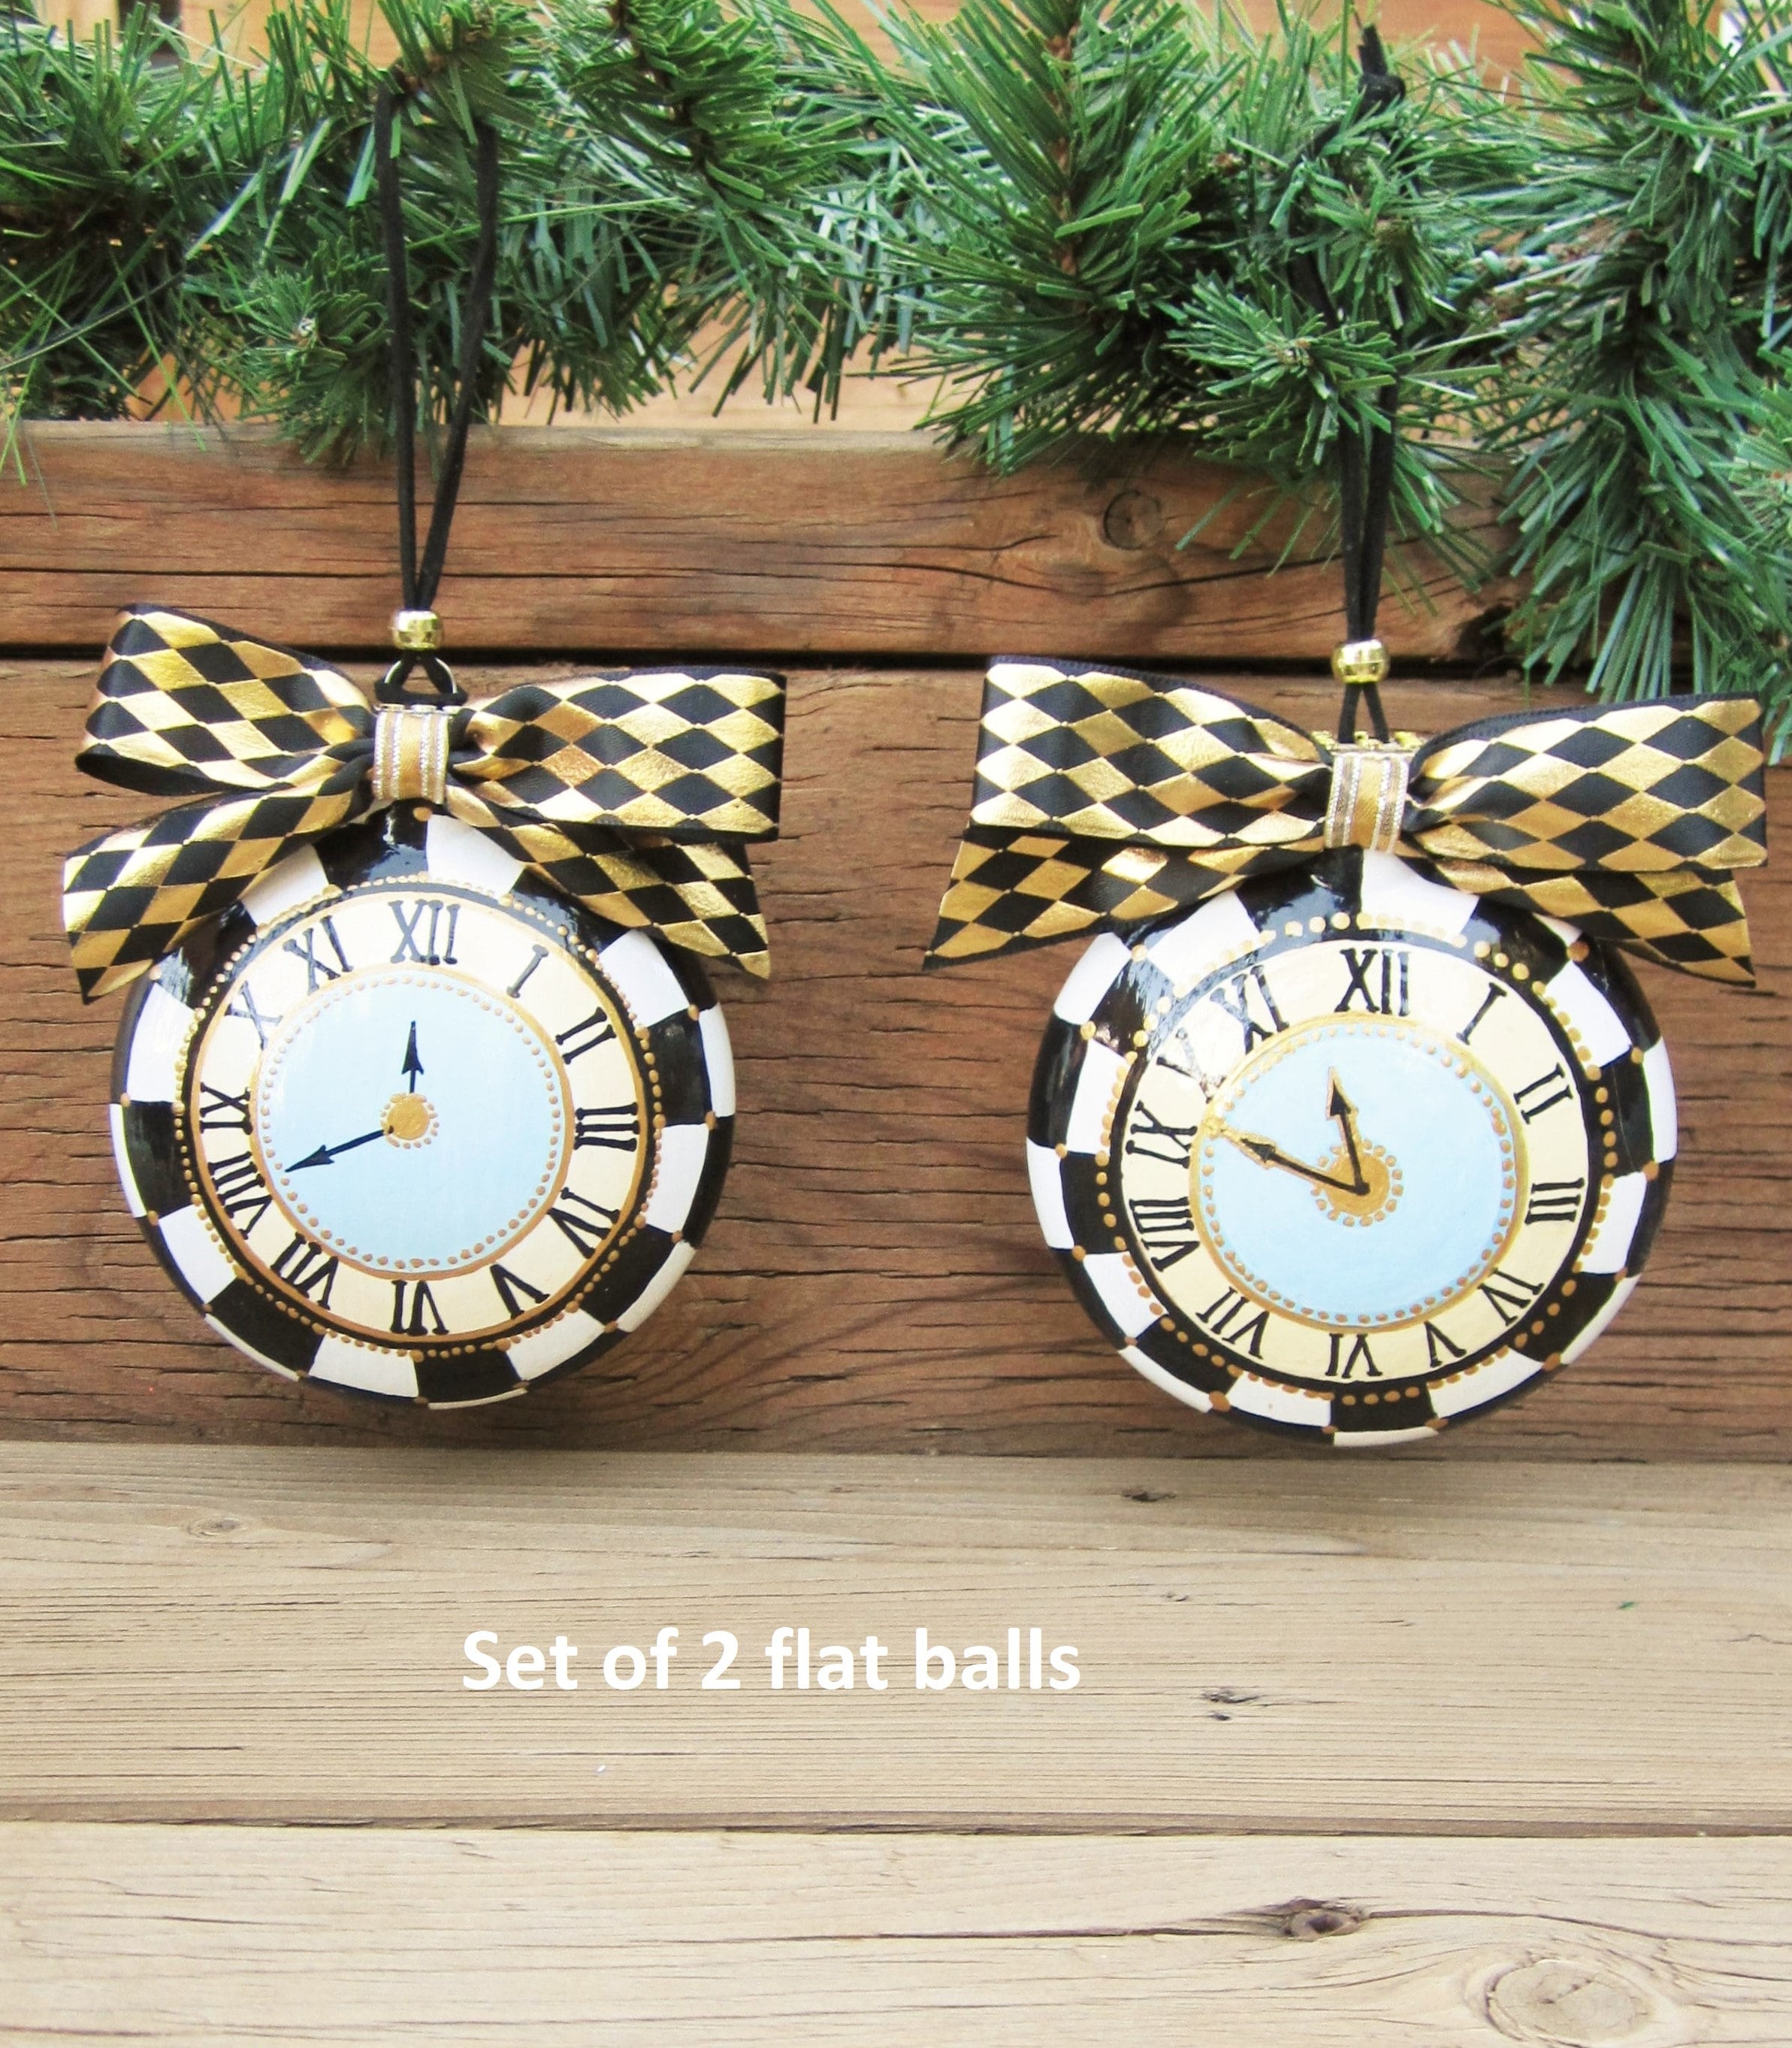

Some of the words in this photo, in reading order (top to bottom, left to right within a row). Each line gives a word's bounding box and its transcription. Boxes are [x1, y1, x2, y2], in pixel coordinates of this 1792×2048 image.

[283, 916, 353, 994] XI
[388, 900, 460, 965] XII
[507, 945, 548, 998] I
[1334, 948, 1410, 1016] XII
[230, 981, 283, 1049] X
[555, 1007, 616, 1064] II
[1210, 966, 1289, 1053] XI
[1456, 982, 1506, 1045] I
[1156, 1027, 1225, 1103] X
[1514, 1063, 1573, 1124] II
[575, 1103, 639, 1151] III
[547, 1188, 621, 1259] IV
[1525, 1178, 1585, 1225] III
[270, 1232, 338, 1310] VII
[491, 1263, 550, 1318] V
[1478, 1268, 1544, 1326] IV
[391, 1281, 449, 1335] VI
[1196, 1287, 1269, 1359] VII
[1325, 1333, 1383, 1378] VI
[1425, 1321, 1466, 1367] V
